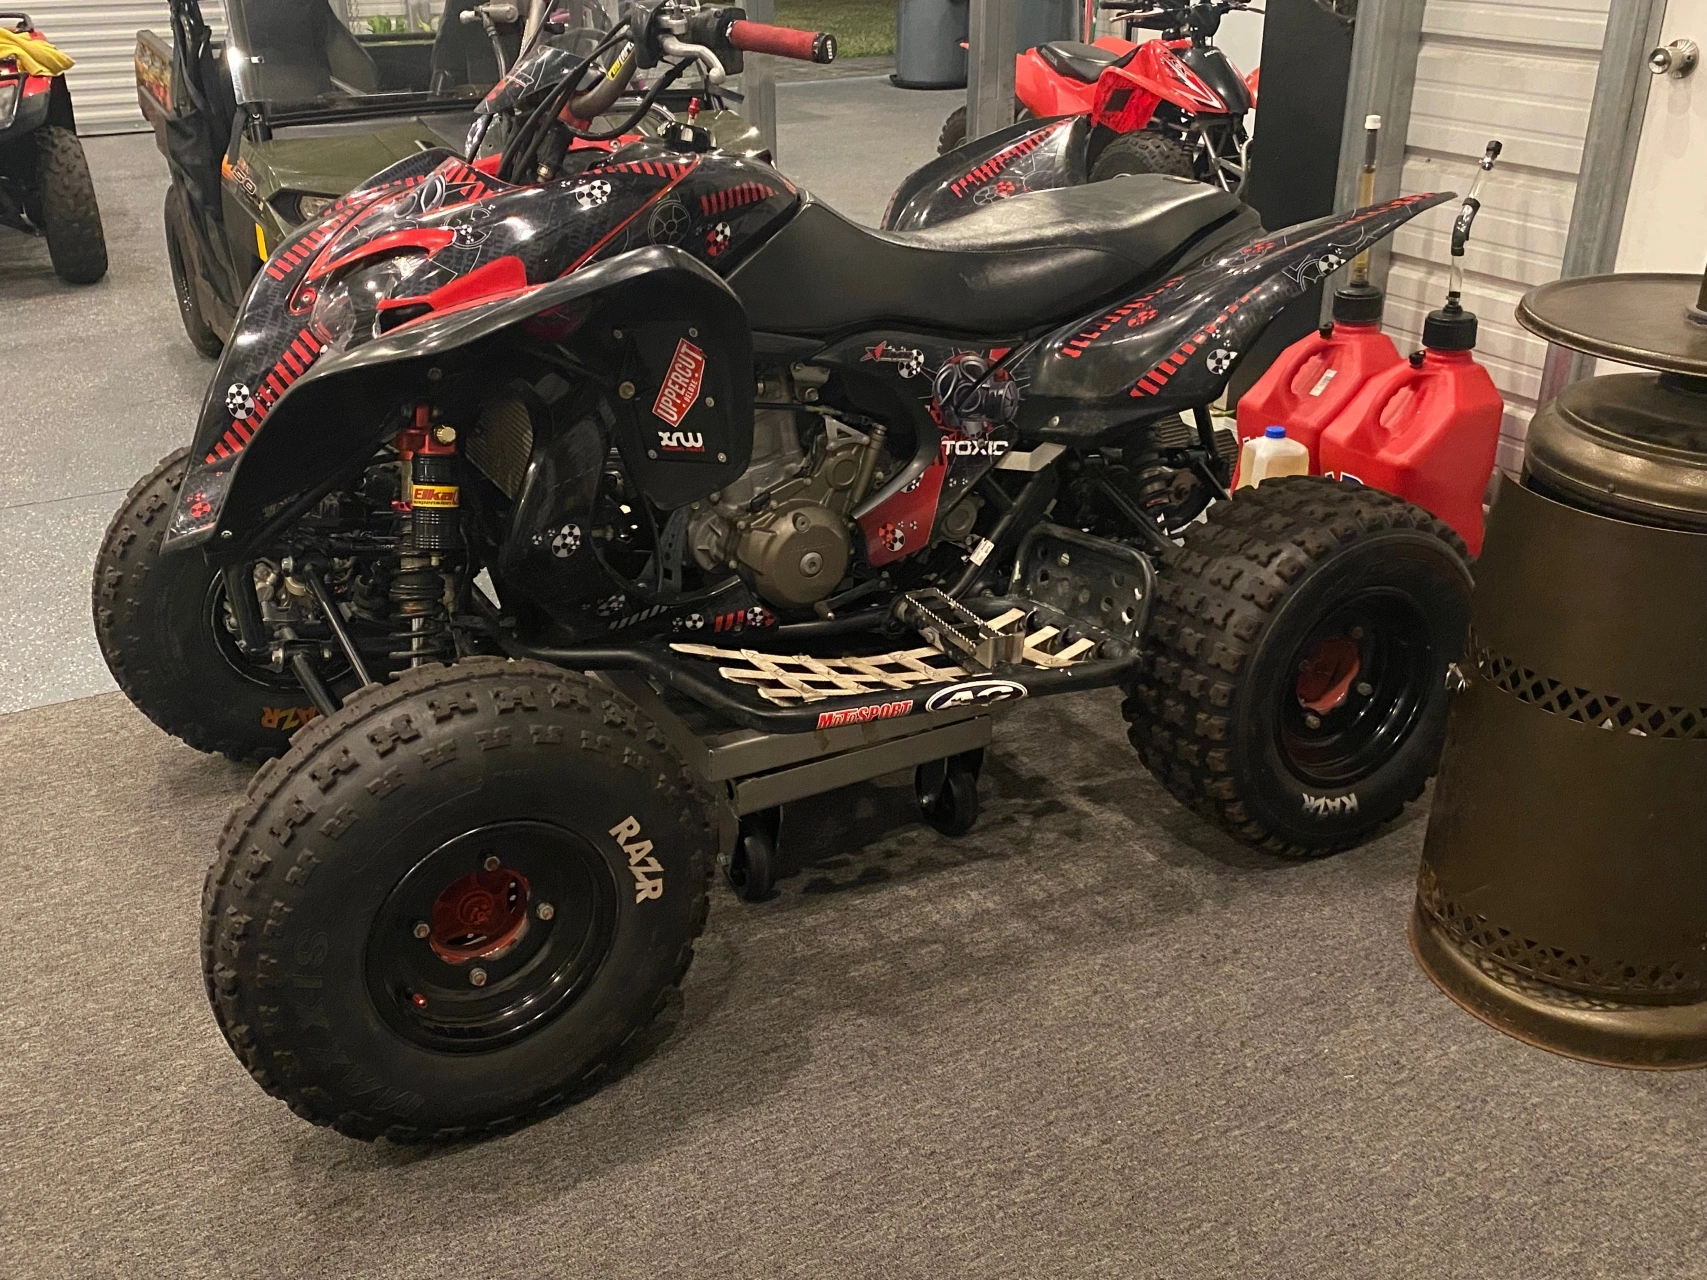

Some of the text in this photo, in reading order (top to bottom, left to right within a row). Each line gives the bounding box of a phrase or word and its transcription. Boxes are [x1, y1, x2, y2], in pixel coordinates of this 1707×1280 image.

[656, 343, 704, 422] UPPERCUT
[941, 440, 1009, 456] TOXIC
[413, 488, 453, 500] Elka
[261, 706, 317, 731] AZR
[608, 815, 665, 904] RAZR
